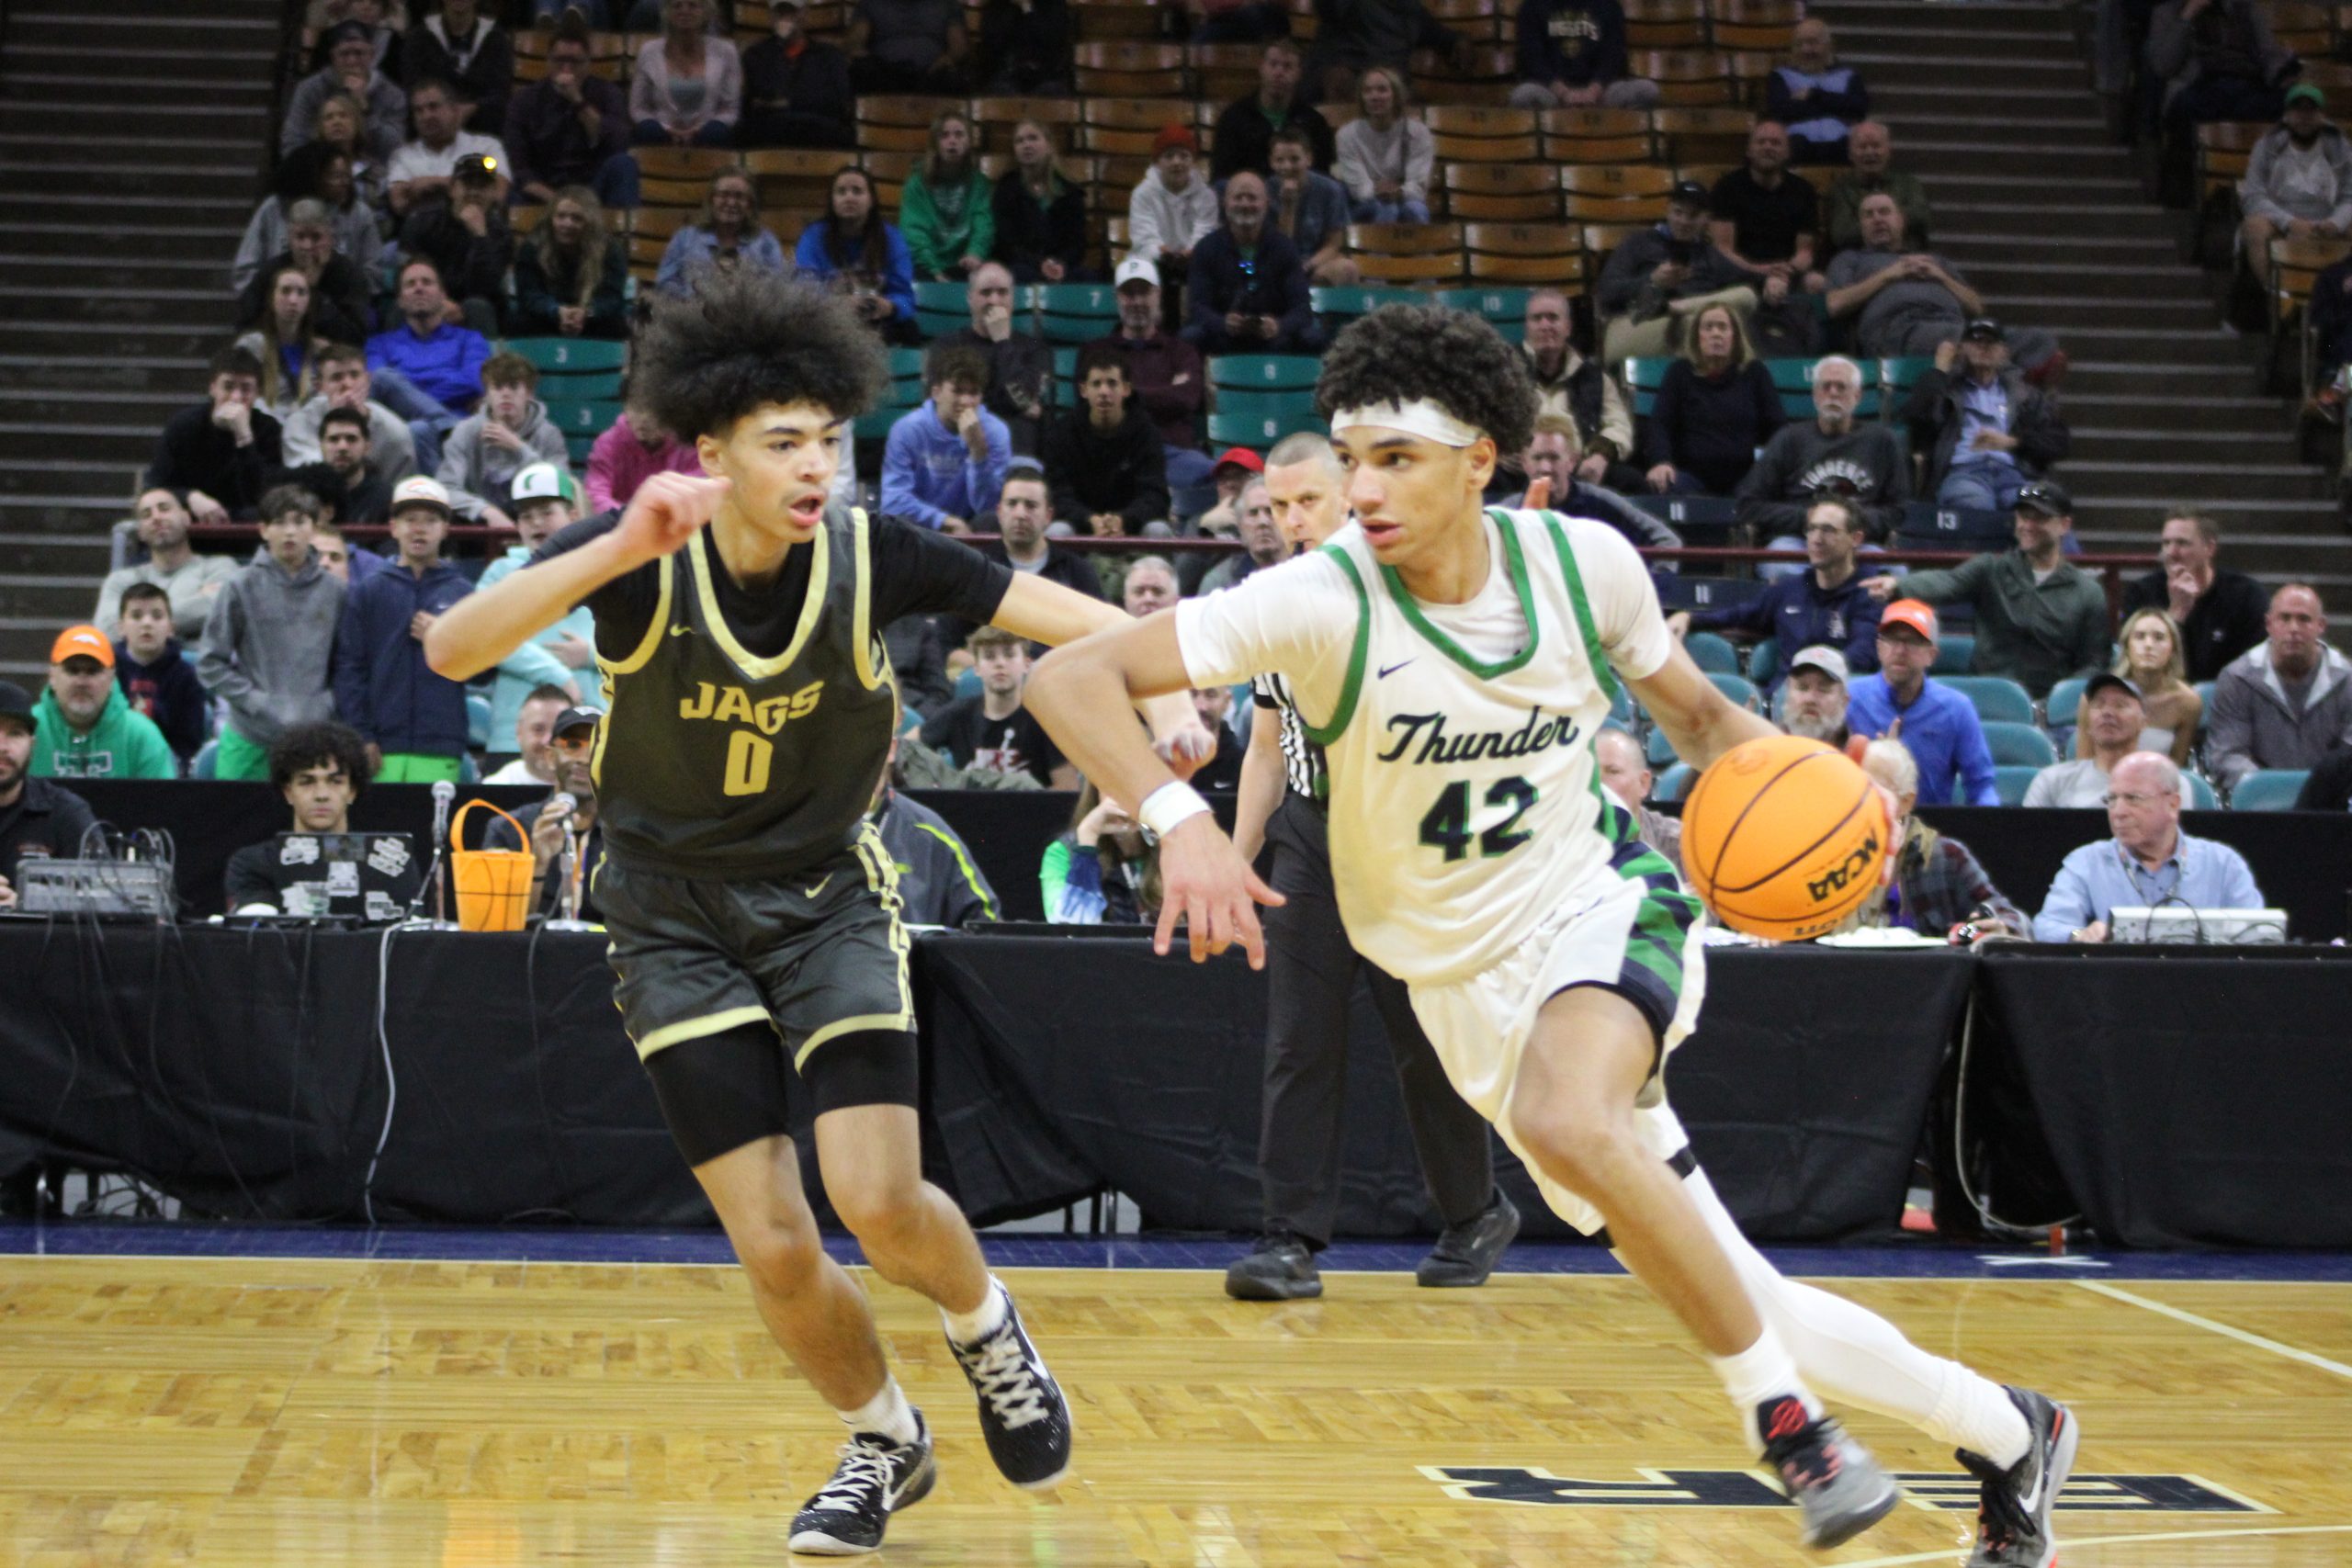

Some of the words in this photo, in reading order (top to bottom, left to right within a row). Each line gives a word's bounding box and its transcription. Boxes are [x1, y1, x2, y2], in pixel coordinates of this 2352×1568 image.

[556, 347, 567, 363] 3
[580, 409, 592, 425] 3
[1669, 502, 1685, 521] 11
[1937, 511, 1959, 530] 13
[1695, 585, 1711, 604] 11
[680, 681, 825, 735] JAGS
[1376, 705, 1579, 764] Thunder
[724, 730, 774, 796] 0
[1418, 775, 1540, 863] 42
[1807, 827, 1878, 902] NCAA
